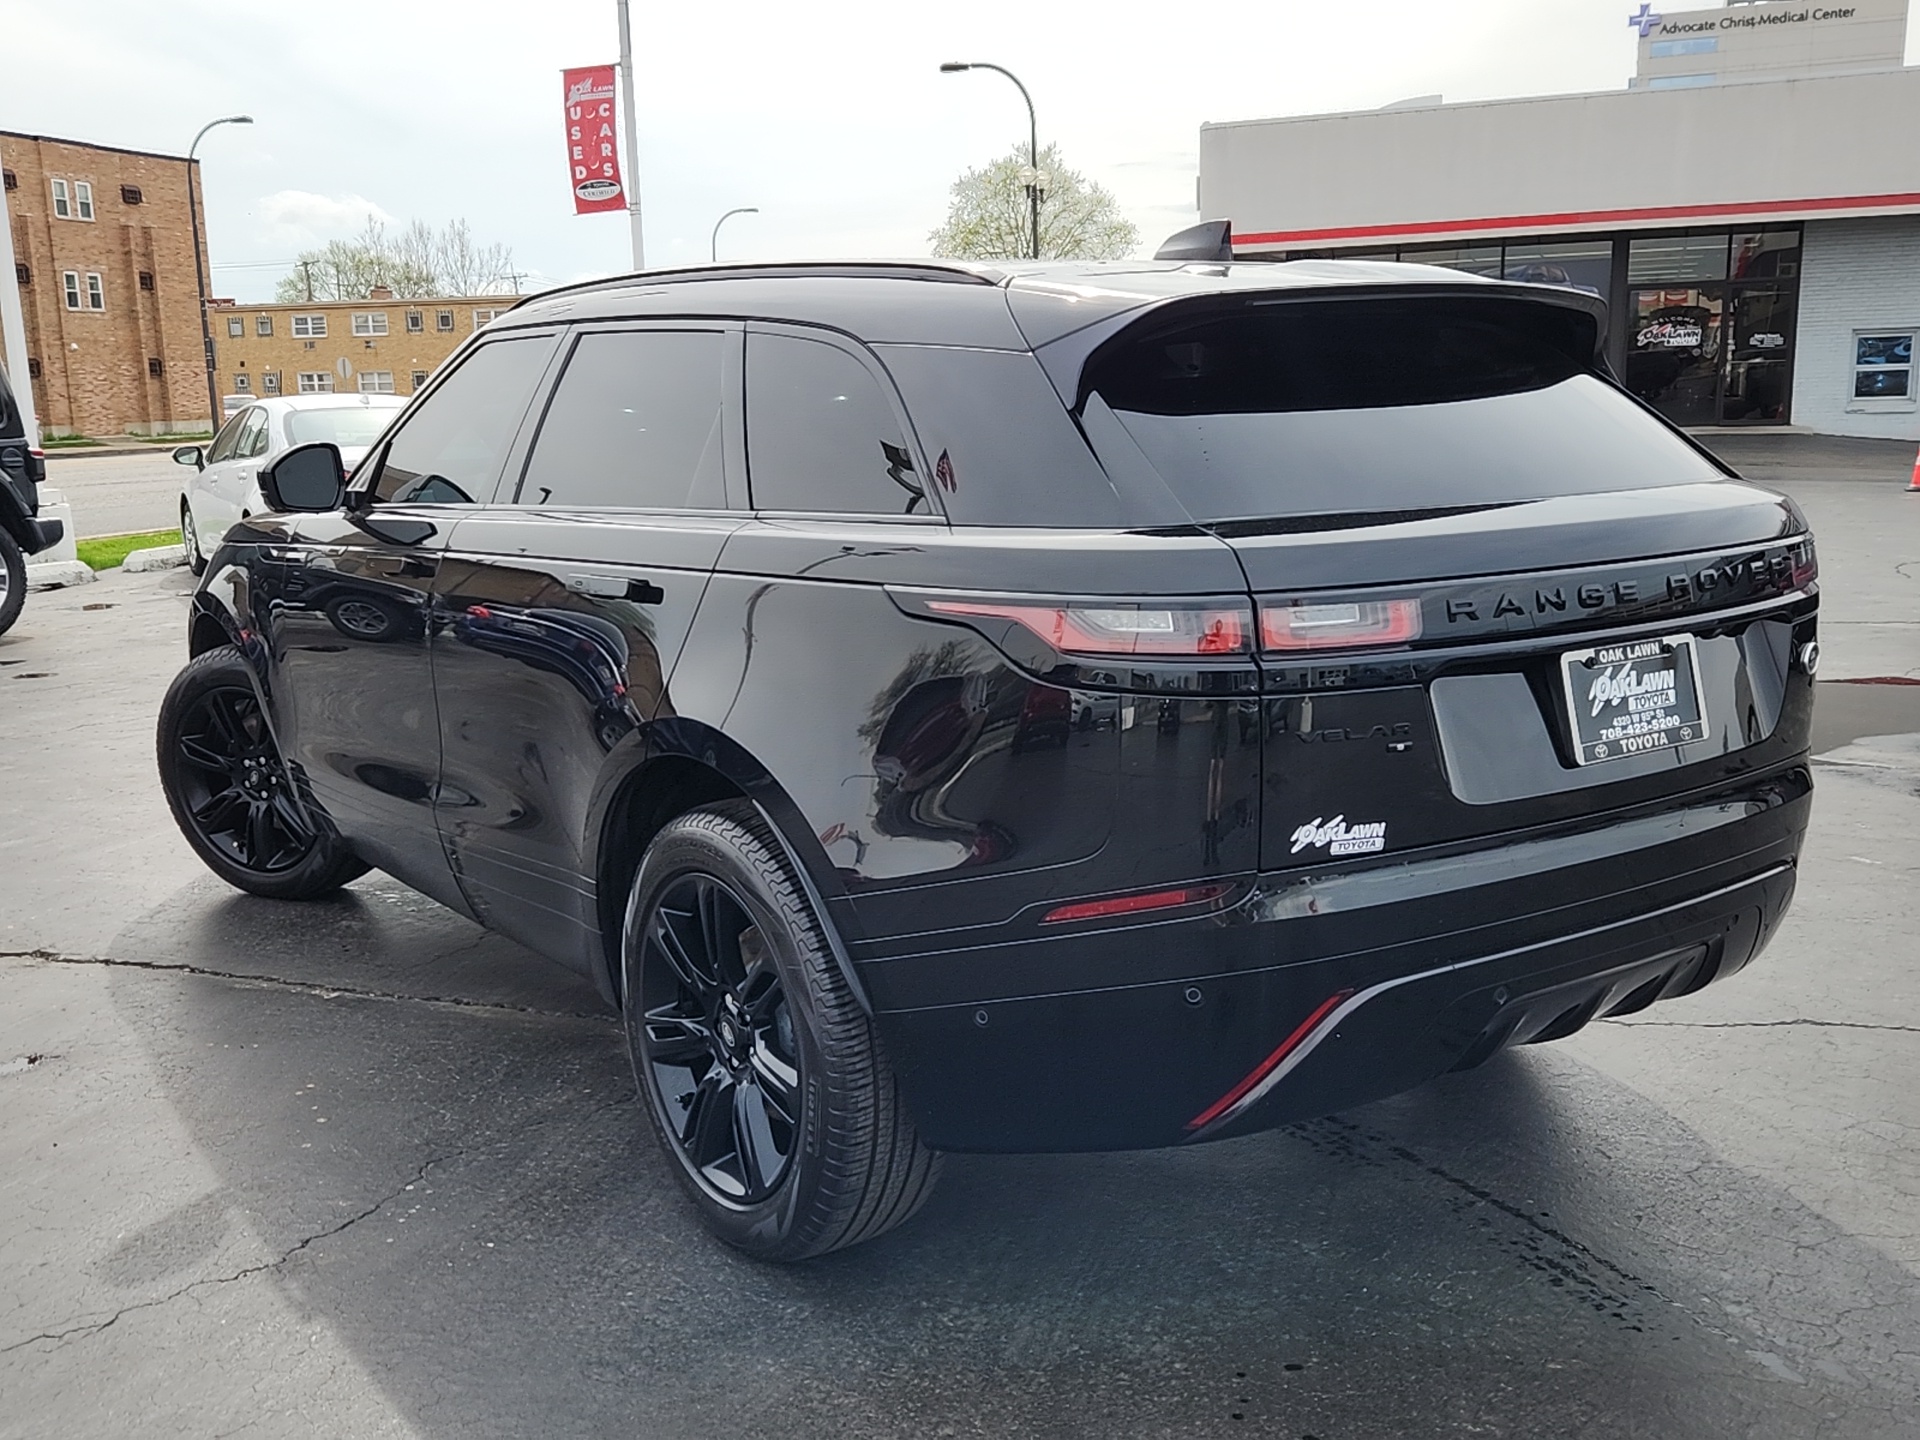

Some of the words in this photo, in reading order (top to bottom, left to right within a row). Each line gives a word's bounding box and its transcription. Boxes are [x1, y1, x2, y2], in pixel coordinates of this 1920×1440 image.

[1659, 21, 1716, 35] Advocate
[1720, 16, 1755, 29] Christ
[1758, 9, 1809, 25] Medical
[1812, 8, 1856, 21] Center
[569, 105, 588, 180] USED
[598, 102, 614, 177] CARS
[1446, 579, 1639, 623] RANGE
[1599, 649, 1625, 663] OAK
[1627, 641, 1661, 658] LAWN
[1633, 691, 1671, 708] TOYOTA
[1631, 713, 1640, 723] W
[1655, 708, 1666, 719] St
[1295, 722, 1412, 744] VELAR
[1599, 714, 1681, 740] 708-423-5200
[1619, 731, 1669, 753] TOYOTA
[1337, 839, 1377, 851] TOYOTA
